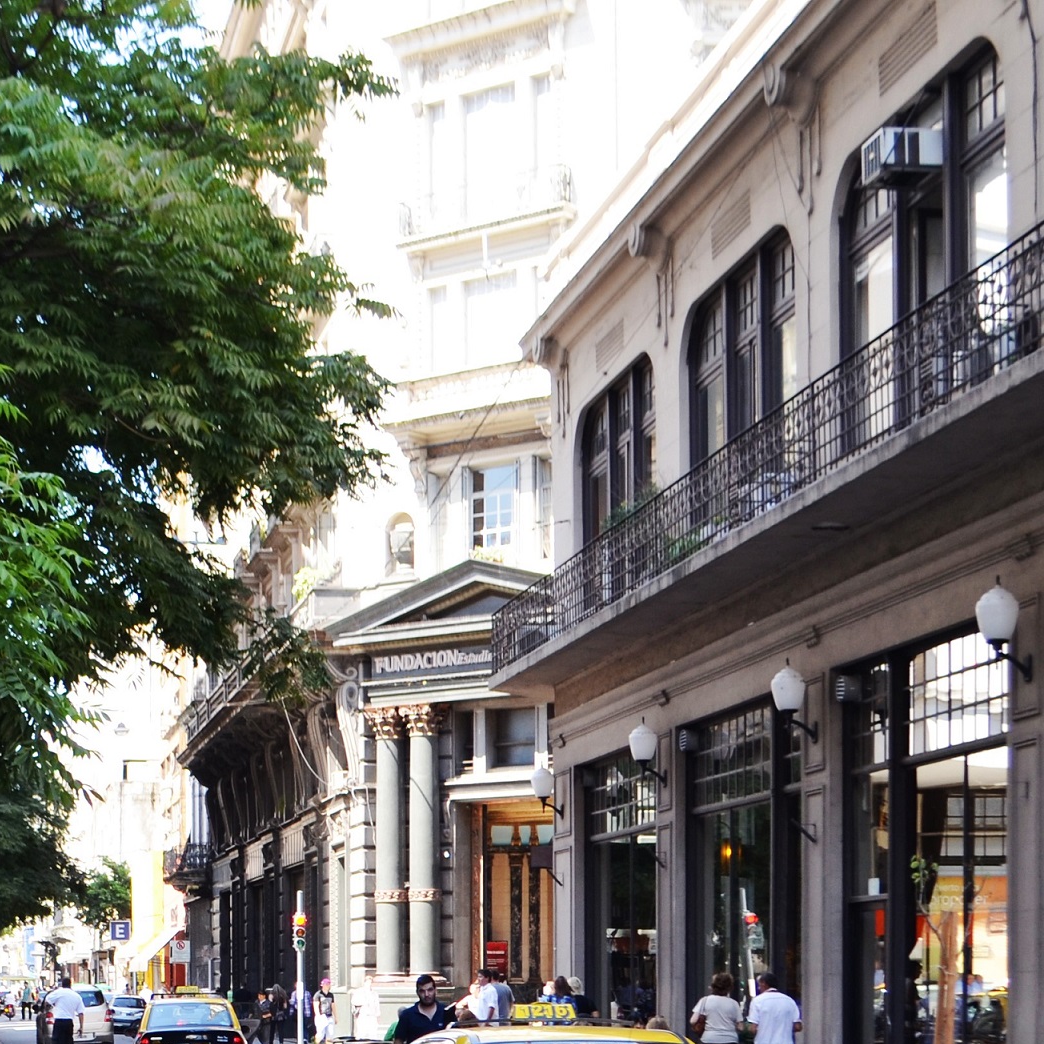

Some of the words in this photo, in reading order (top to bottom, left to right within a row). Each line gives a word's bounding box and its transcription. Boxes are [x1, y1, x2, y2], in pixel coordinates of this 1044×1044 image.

[375, 649, 458, 673] FUNDACION
[116, 924, 125, 938] E
[518, 1003, 570, 1018] 1216
